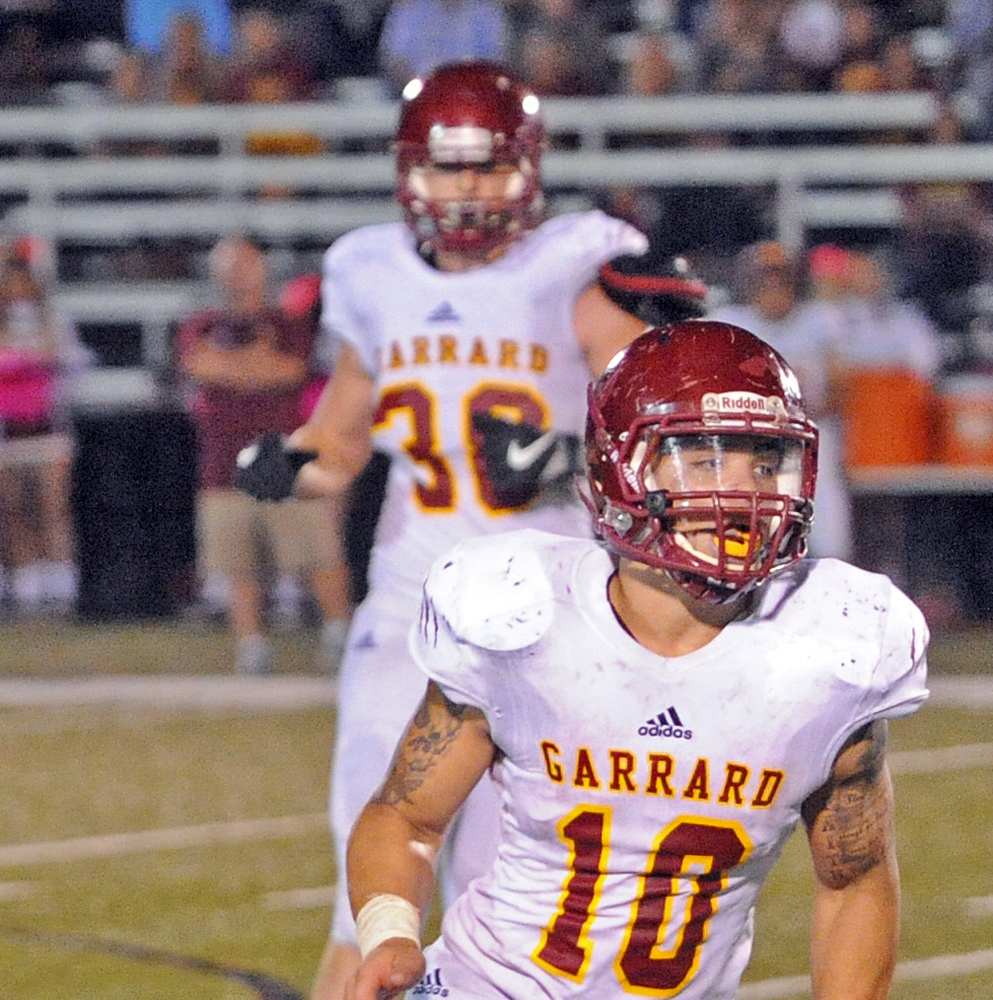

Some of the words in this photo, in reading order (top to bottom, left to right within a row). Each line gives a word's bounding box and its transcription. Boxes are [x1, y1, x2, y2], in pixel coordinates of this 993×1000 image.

[722, 396, 765, 411] Riddell
[638, 725, 693, 740] adidas
[540, 737, 784, 809] GARRARD
[529, 803, 755, 999] 10
